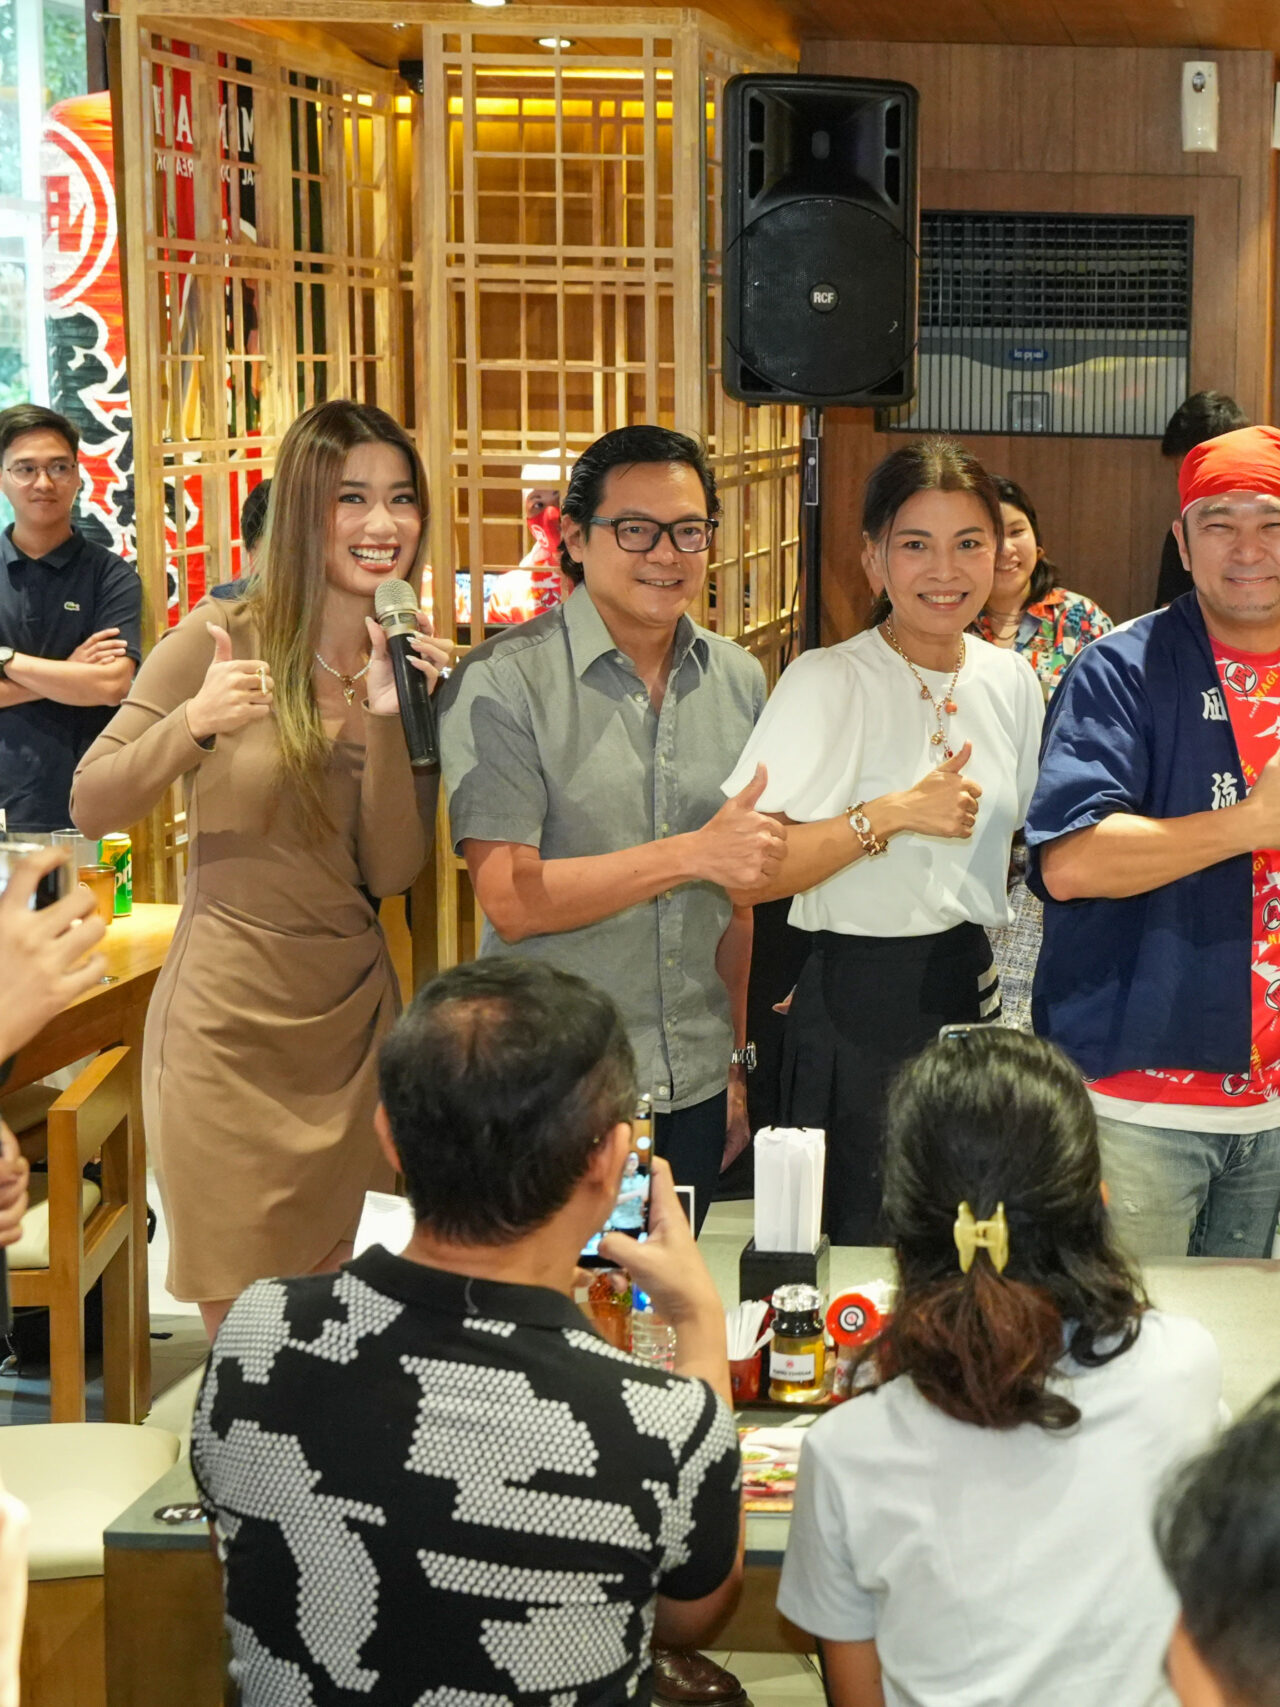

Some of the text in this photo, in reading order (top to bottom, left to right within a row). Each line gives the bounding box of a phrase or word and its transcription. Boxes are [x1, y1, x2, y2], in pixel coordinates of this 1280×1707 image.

[813, 291, 835, 304] RCF
[1253, 670, 1280, 701] NAGI
[162, 1508, 201, 1519] K1
